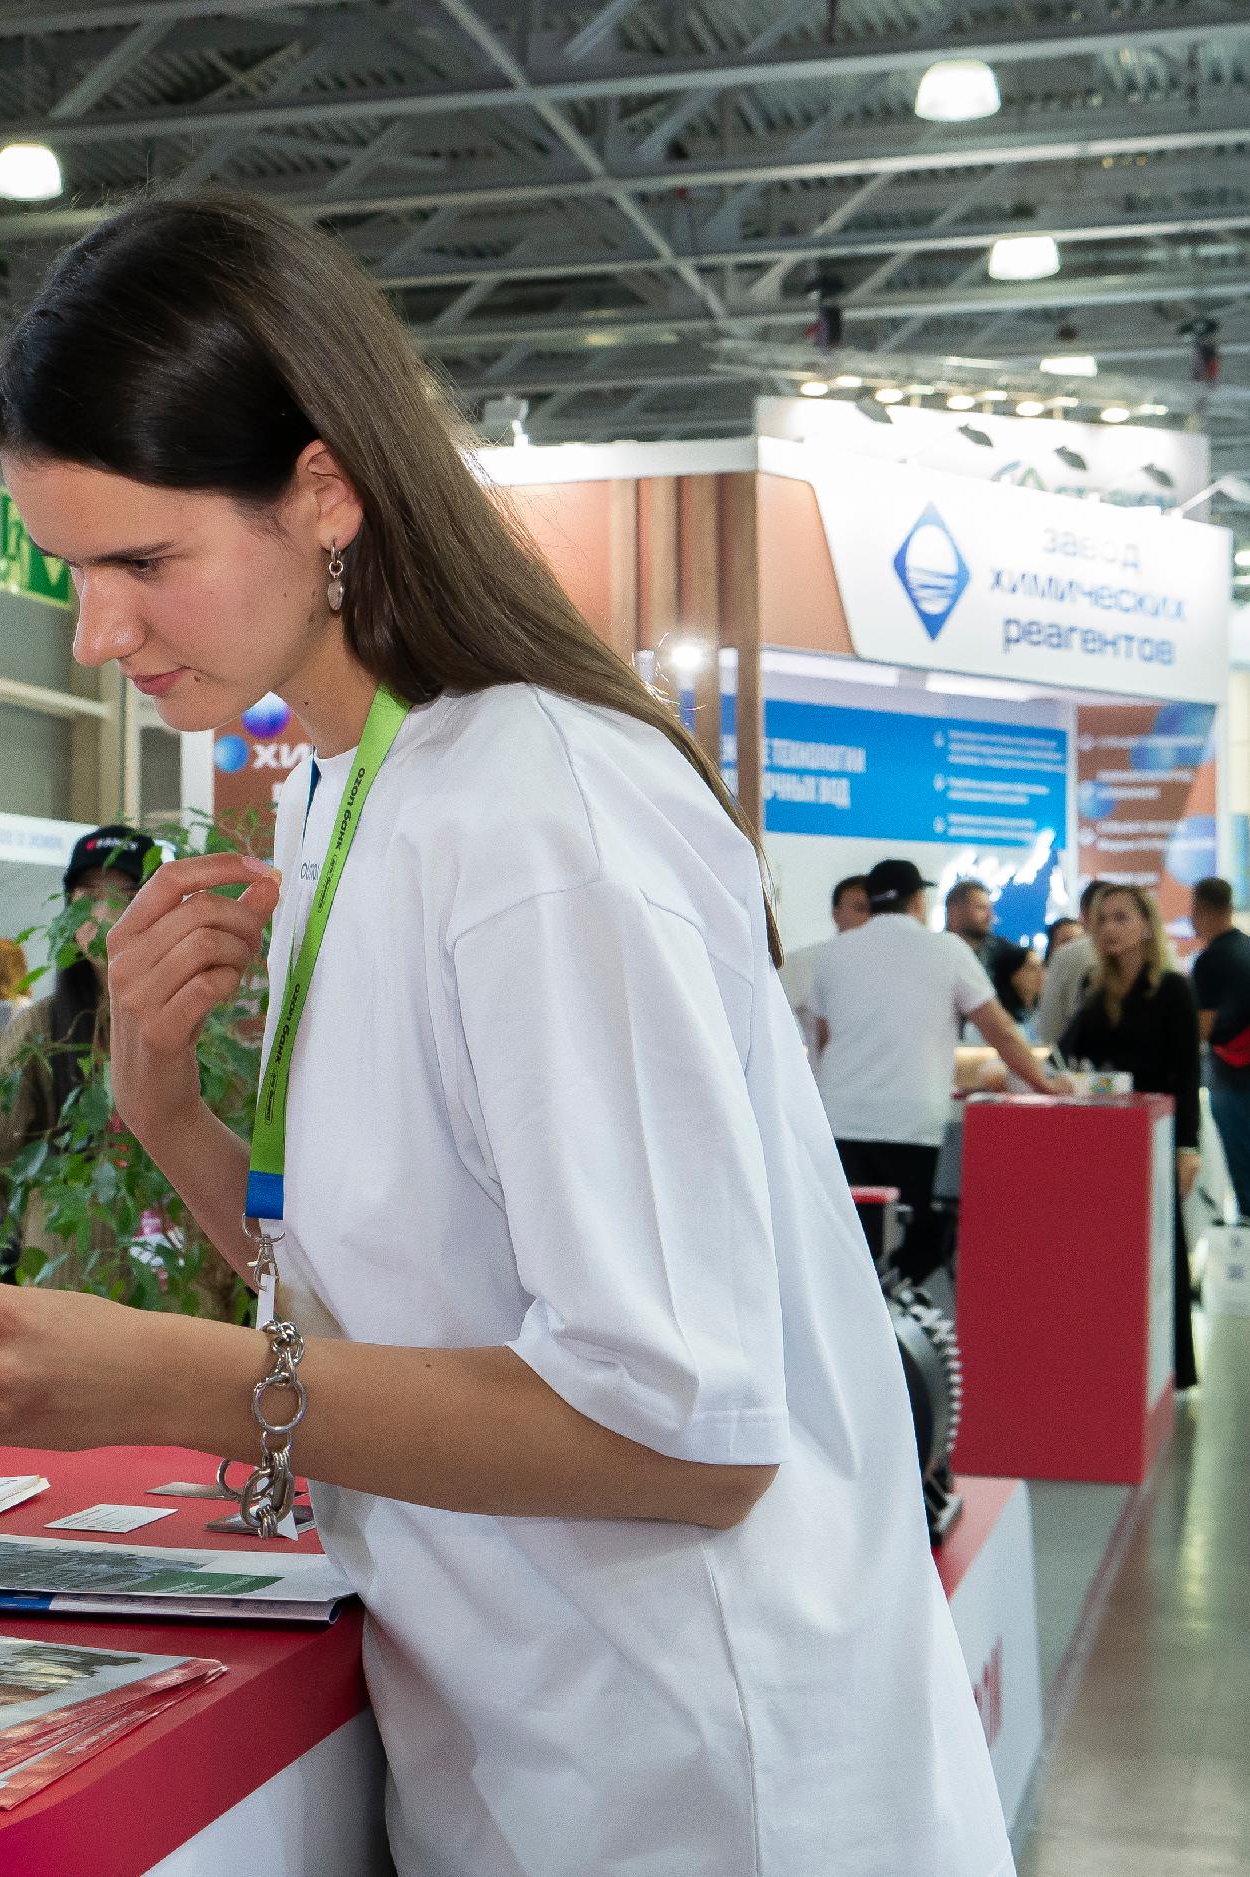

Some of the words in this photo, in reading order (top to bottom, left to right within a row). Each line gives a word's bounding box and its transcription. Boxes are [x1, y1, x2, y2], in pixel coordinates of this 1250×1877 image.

[1043, 527, 1141, 573] завод
[990, 567, 1186, 621] химических
[1003, 617, 1176, 666] реагентов
[346, 767, 366, 806] ozon
[335, 809, 353, 850] банк
[286, 983, 300, 1022] ozon
[275, 1024, 290, 1064] банк
